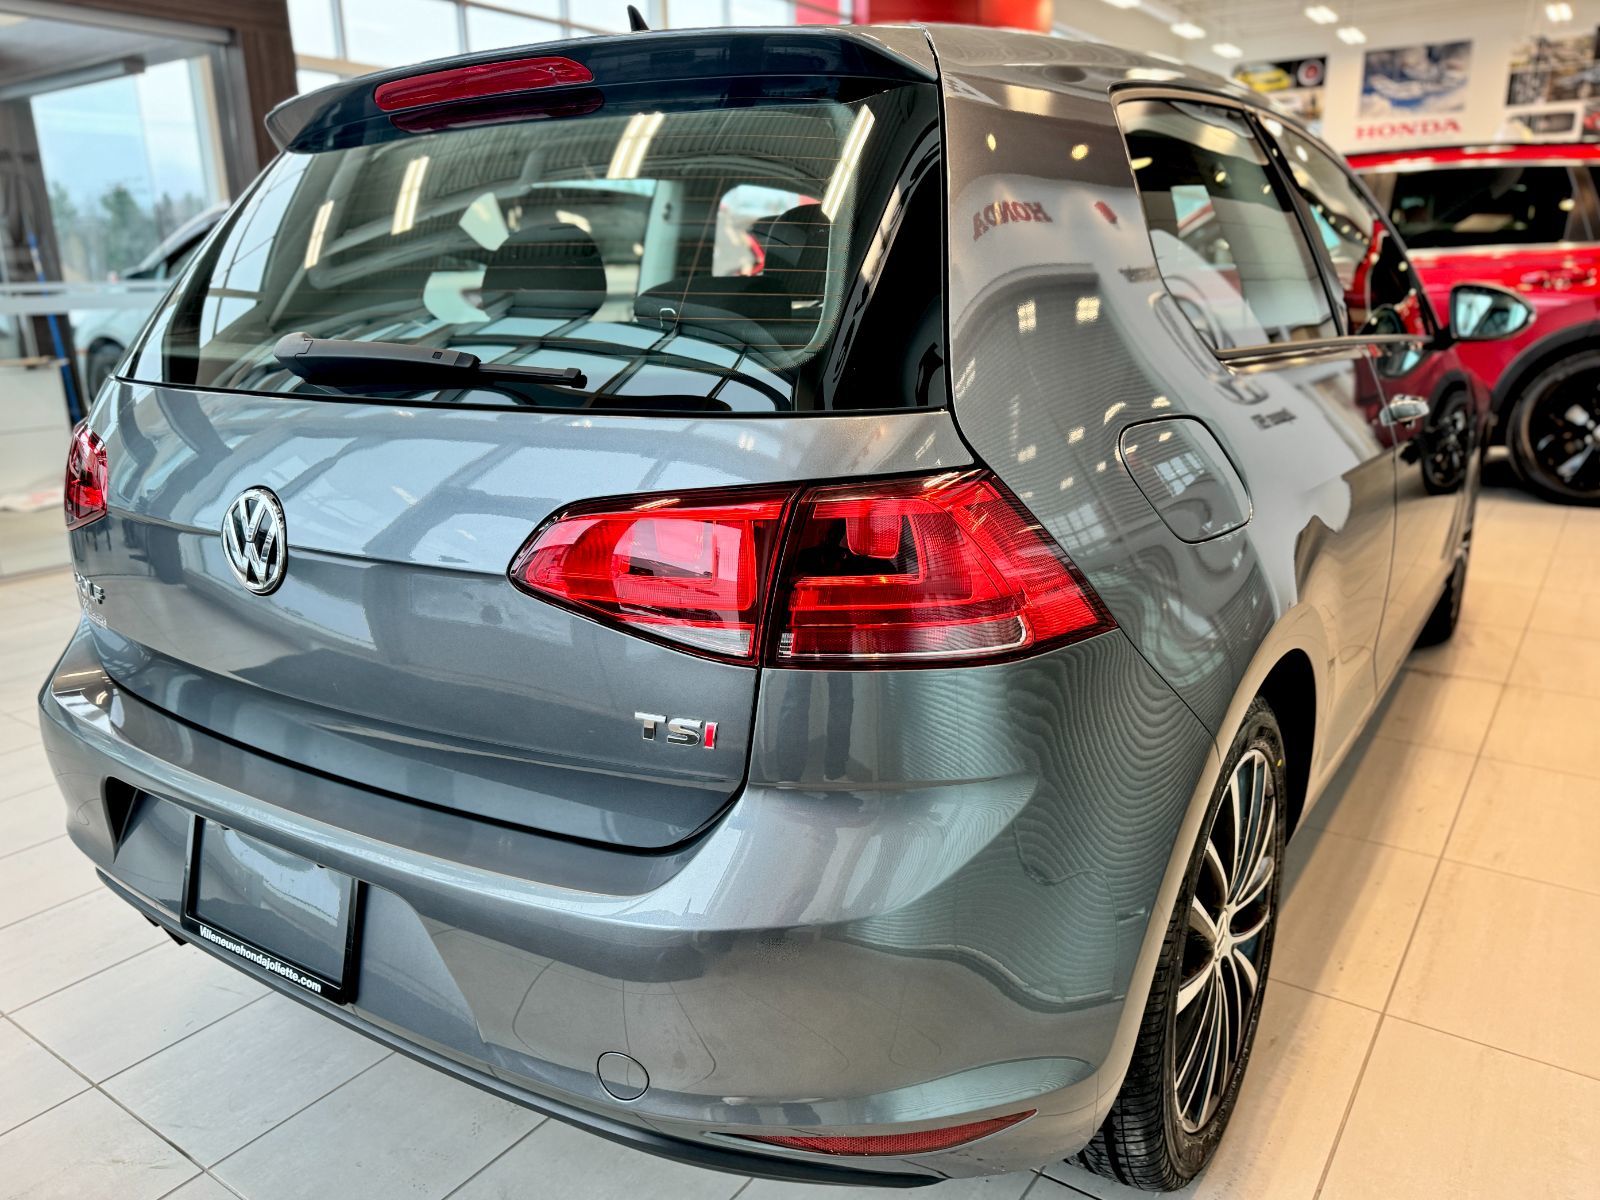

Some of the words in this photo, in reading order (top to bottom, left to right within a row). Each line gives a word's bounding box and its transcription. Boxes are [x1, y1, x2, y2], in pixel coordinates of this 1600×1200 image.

[1355, 118, 1462, 141] HONDA
[221, 486, 288, 595] VW
[634, 711, 719, 749] TSI
[199, 925, 322, 993] Villeneuvehondajoliette.com
